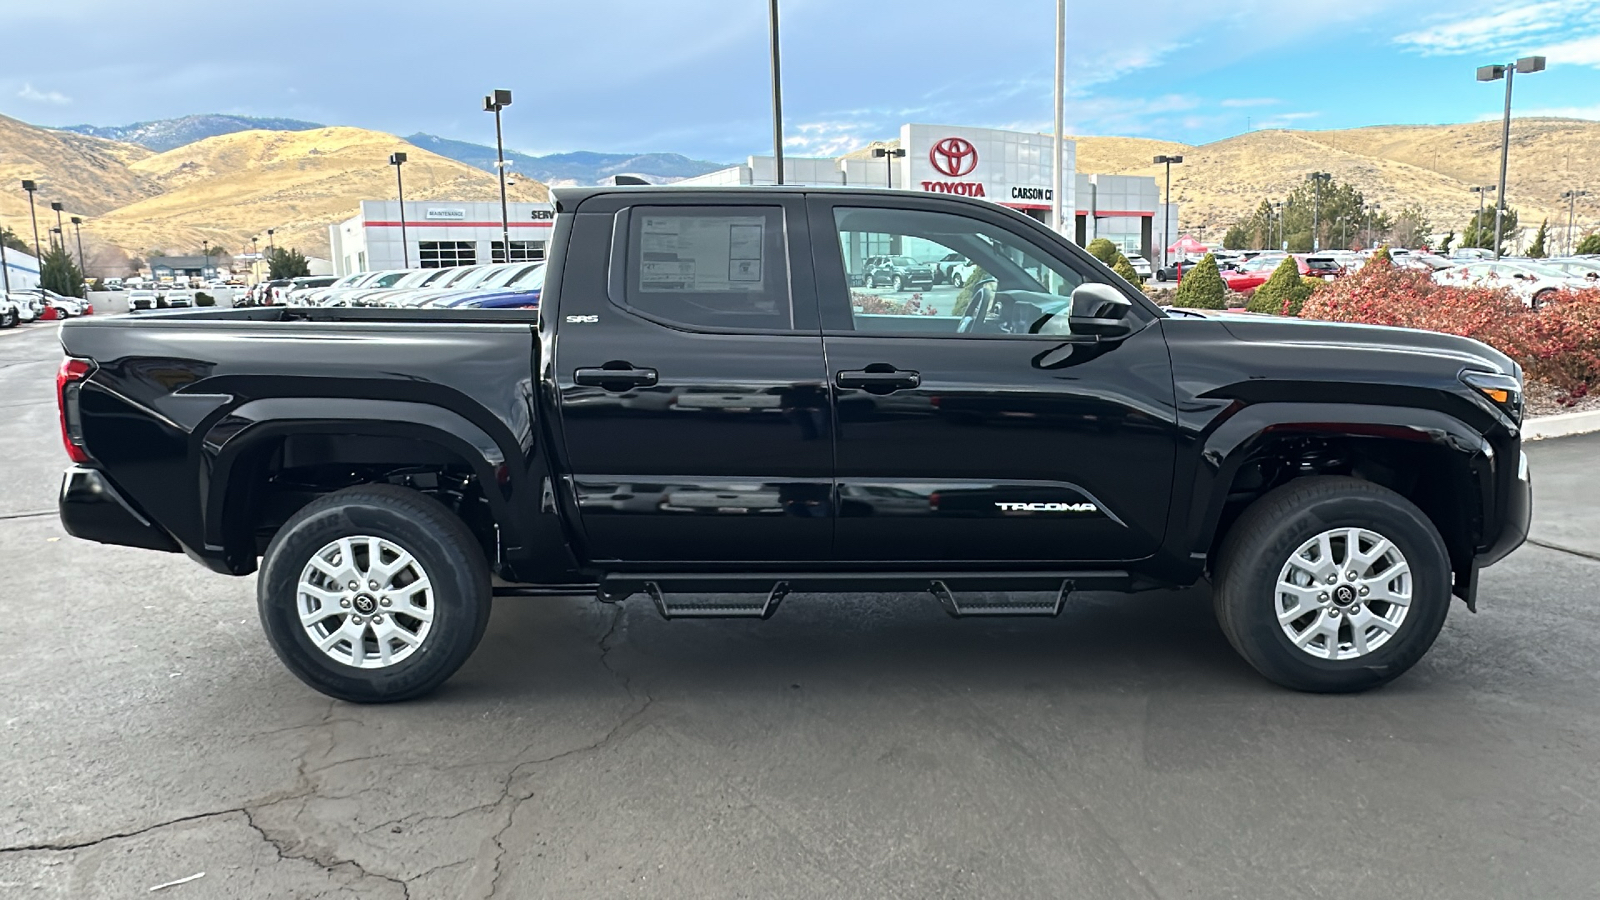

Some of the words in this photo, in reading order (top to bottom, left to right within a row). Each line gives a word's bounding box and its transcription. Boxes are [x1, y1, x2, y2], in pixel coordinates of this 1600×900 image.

[921, 181, 986, 197] TOYOTA
[1011, 186, 1044, 200] CARSON
[995, 502, 1097, 511] TACOMA
